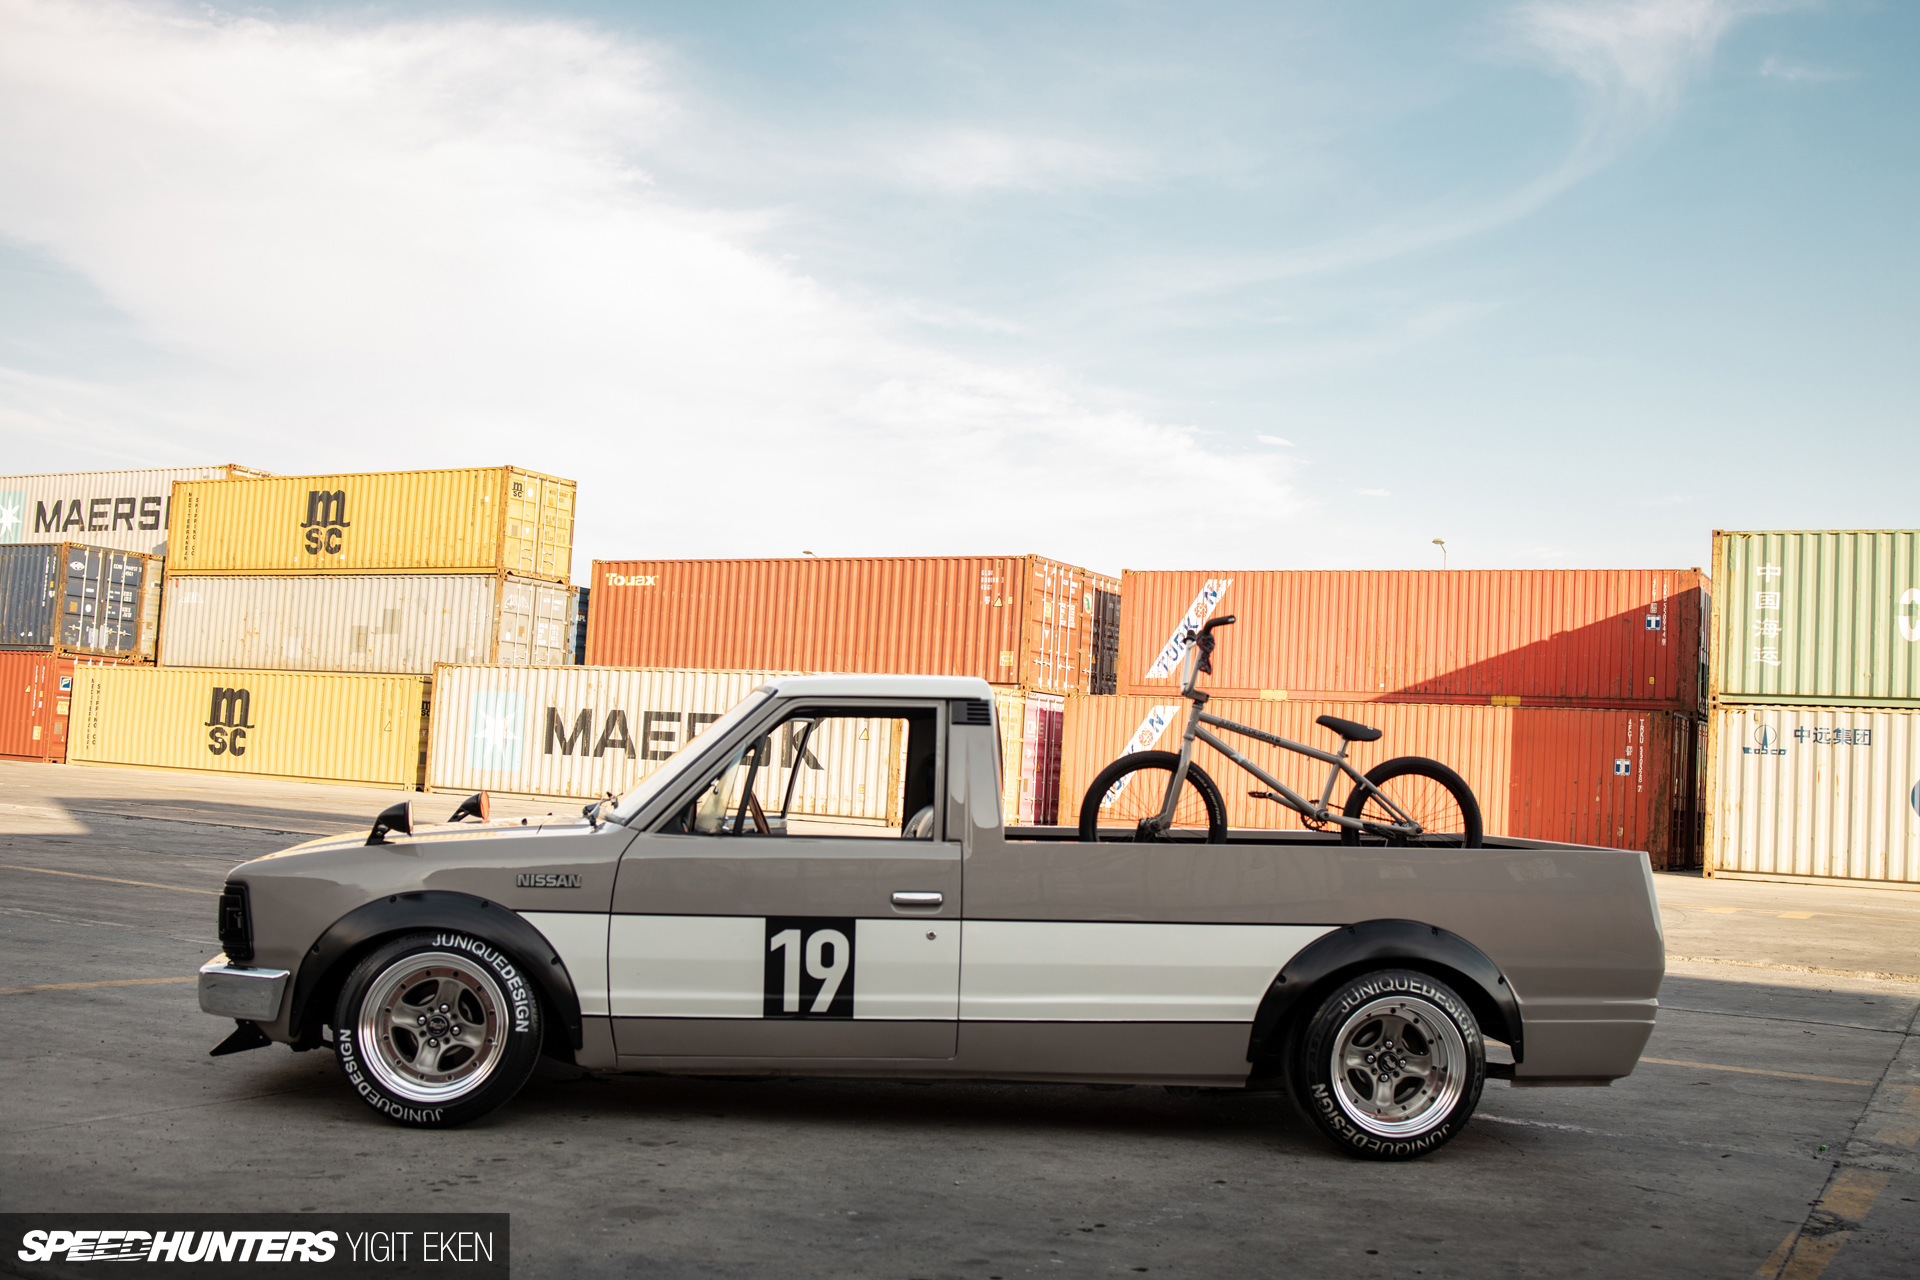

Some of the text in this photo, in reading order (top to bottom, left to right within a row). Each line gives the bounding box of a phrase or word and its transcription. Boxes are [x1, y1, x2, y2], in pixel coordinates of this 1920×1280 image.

[1751, 562, 1782, 667] 中国海运
[1793, 725, 1872, 747] 中远集团
[517, 873, 582, 889] NISSAN
[431, 933, 530, 1033] JUNIQUEDESIGN
[770, 928, 850, 1013] 19
[1341, 975, 1479, 1044] JUNIQUEDESIGN
[339, 1028, 444, 1123] JUNIQUEDESIGN
[1311, 1082, 1451, 1156] JUNIQUEDESIGN
